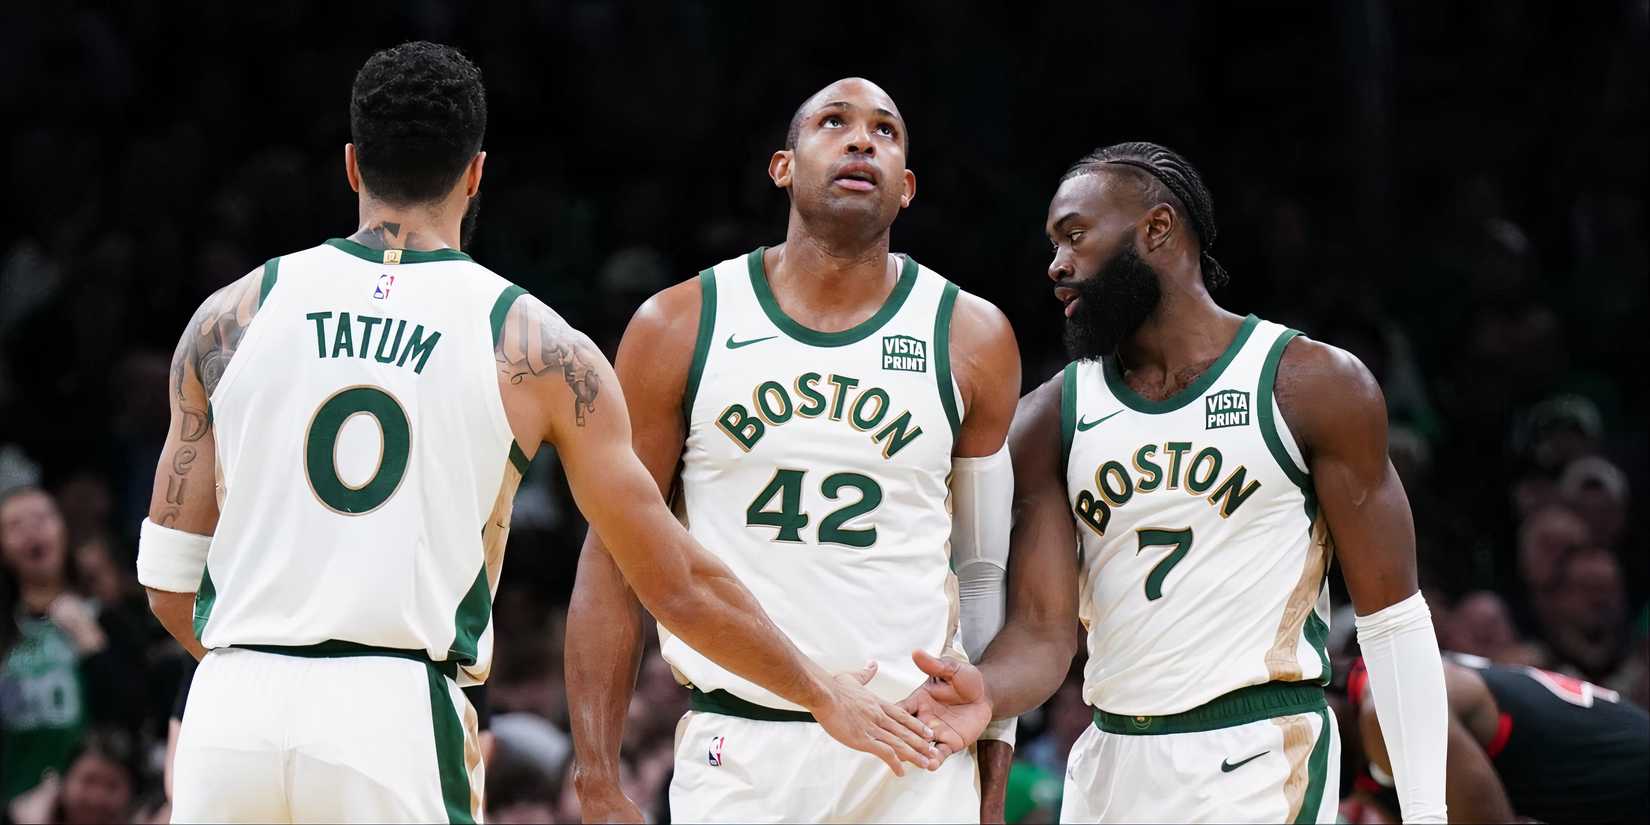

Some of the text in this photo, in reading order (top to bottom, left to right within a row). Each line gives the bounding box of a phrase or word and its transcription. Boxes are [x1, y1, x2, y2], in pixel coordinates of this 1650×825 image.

[306, 311, 442, 375] TATUM
[883, 338, 925, 358] VISTA
[883, 354, 925, 371] PRINT
[714, 371, 924, 460] BOSTON
[1207, 393, 1248, 413] VISTA
[1207, 411, 1248, 428] PRINT
[303, 384, 414, 517] 0
[746, 466, 885, 549] 42
[1074, 441, 1263, 537] BOSTON
[1135, 525, 1194, 602] 7
